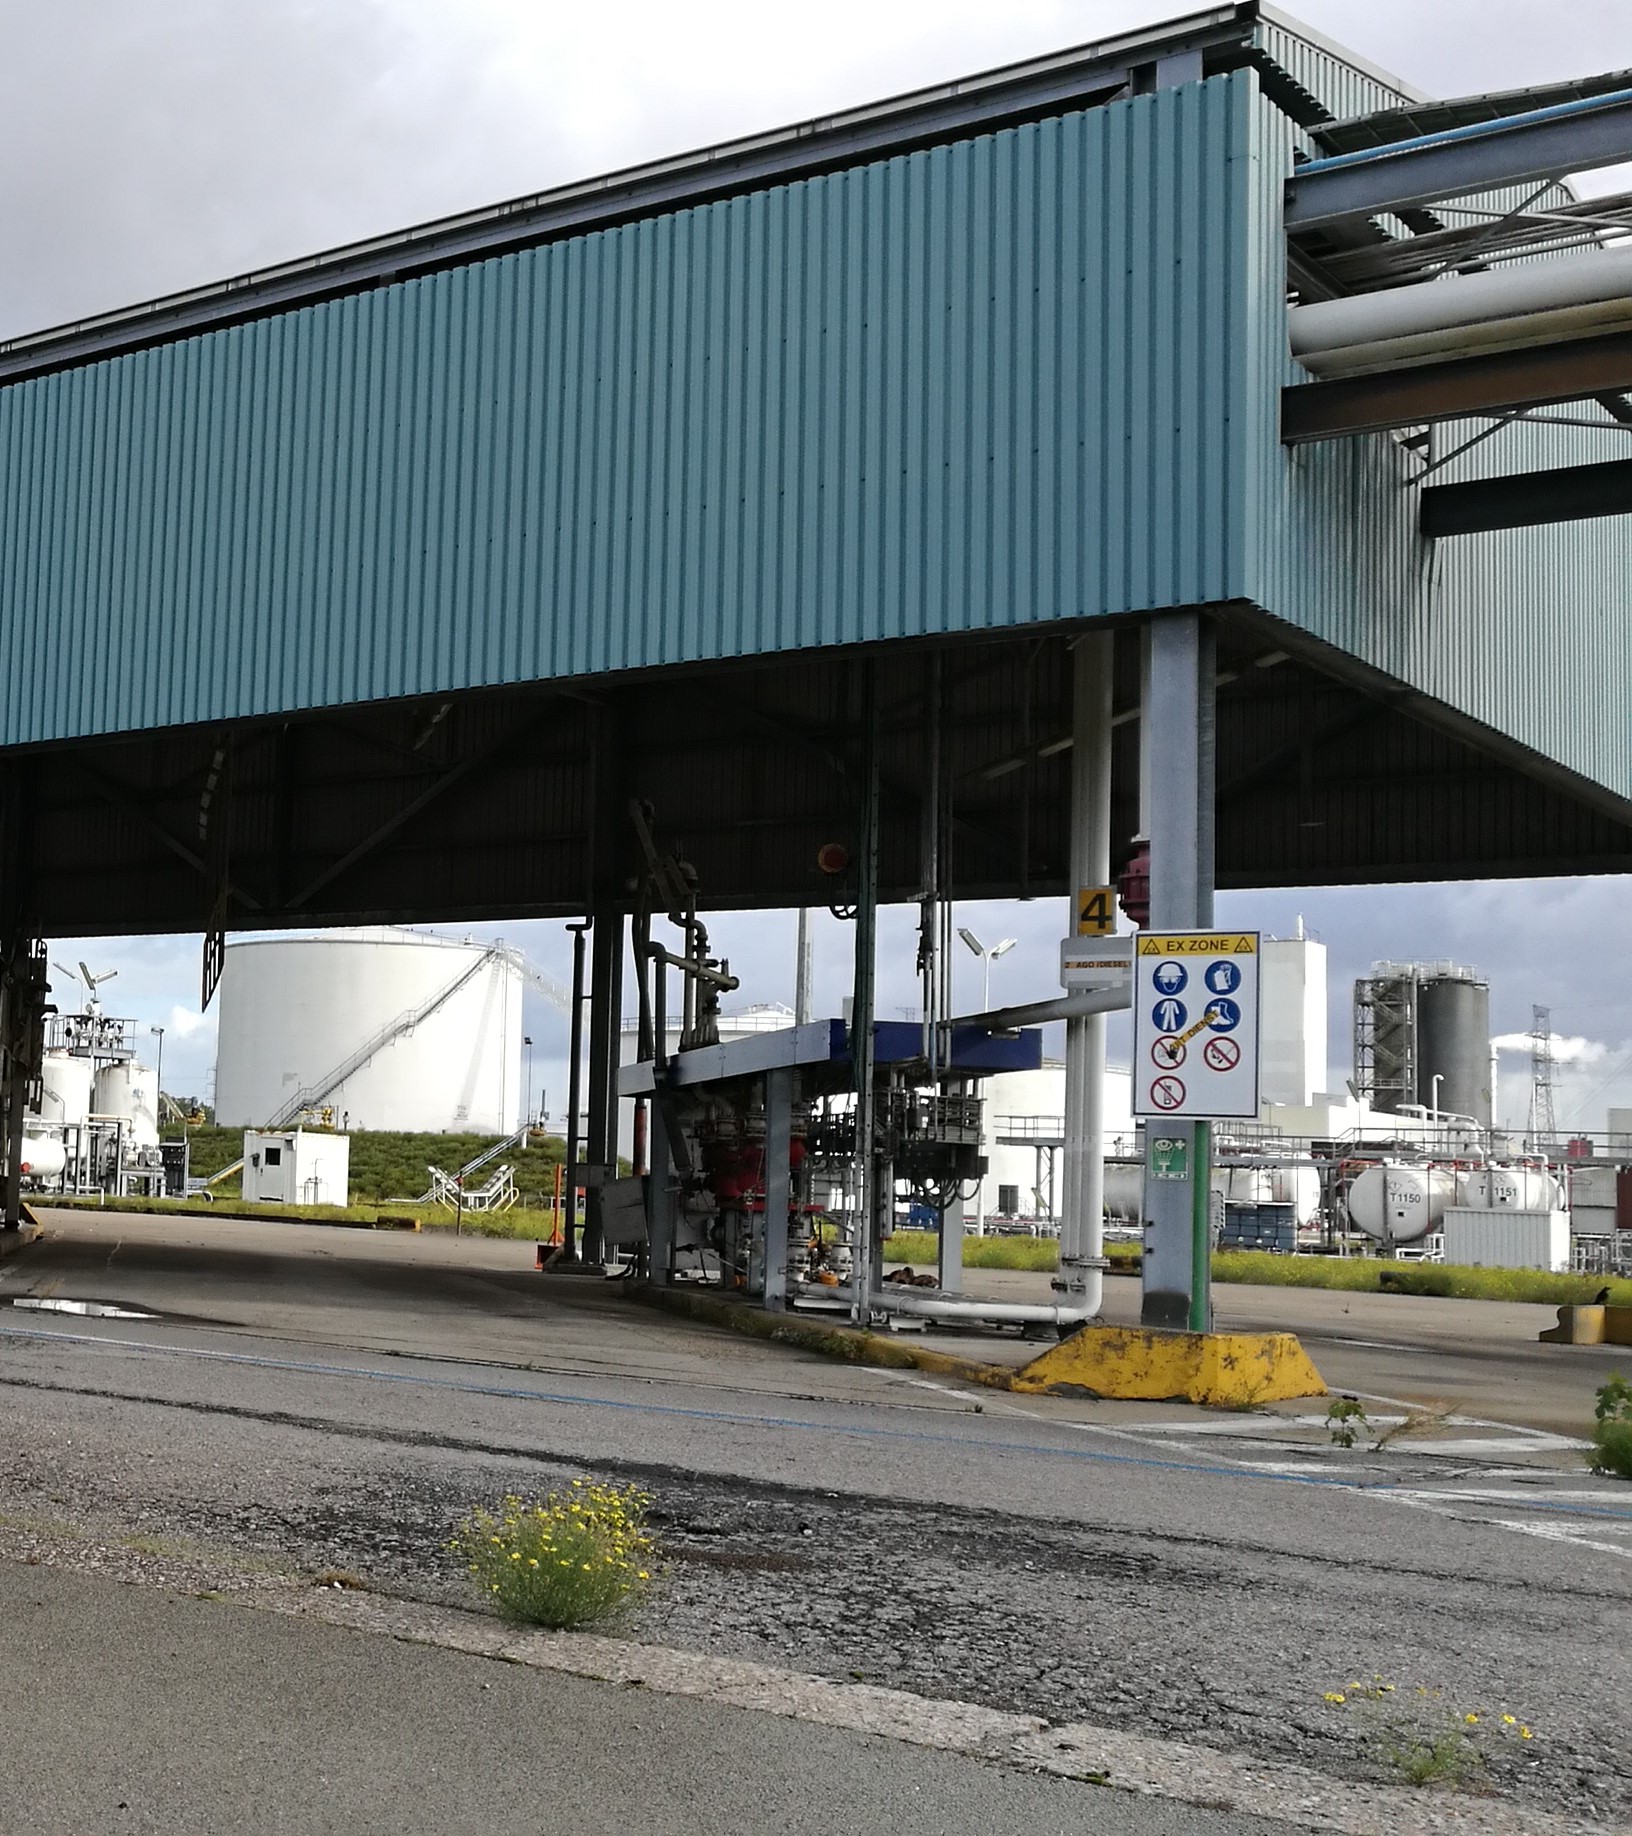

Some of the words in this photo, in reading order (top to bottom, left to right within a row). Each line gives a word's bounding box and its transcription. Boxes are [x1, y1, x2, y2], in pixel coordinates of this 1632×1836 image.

[1081, 893, 1113, 929] 4
[1166, 940, 1185, 952] EX
[1189, 939, 1230, 952] ZONE
[1390, 1192, 1421, 1204] T1150
